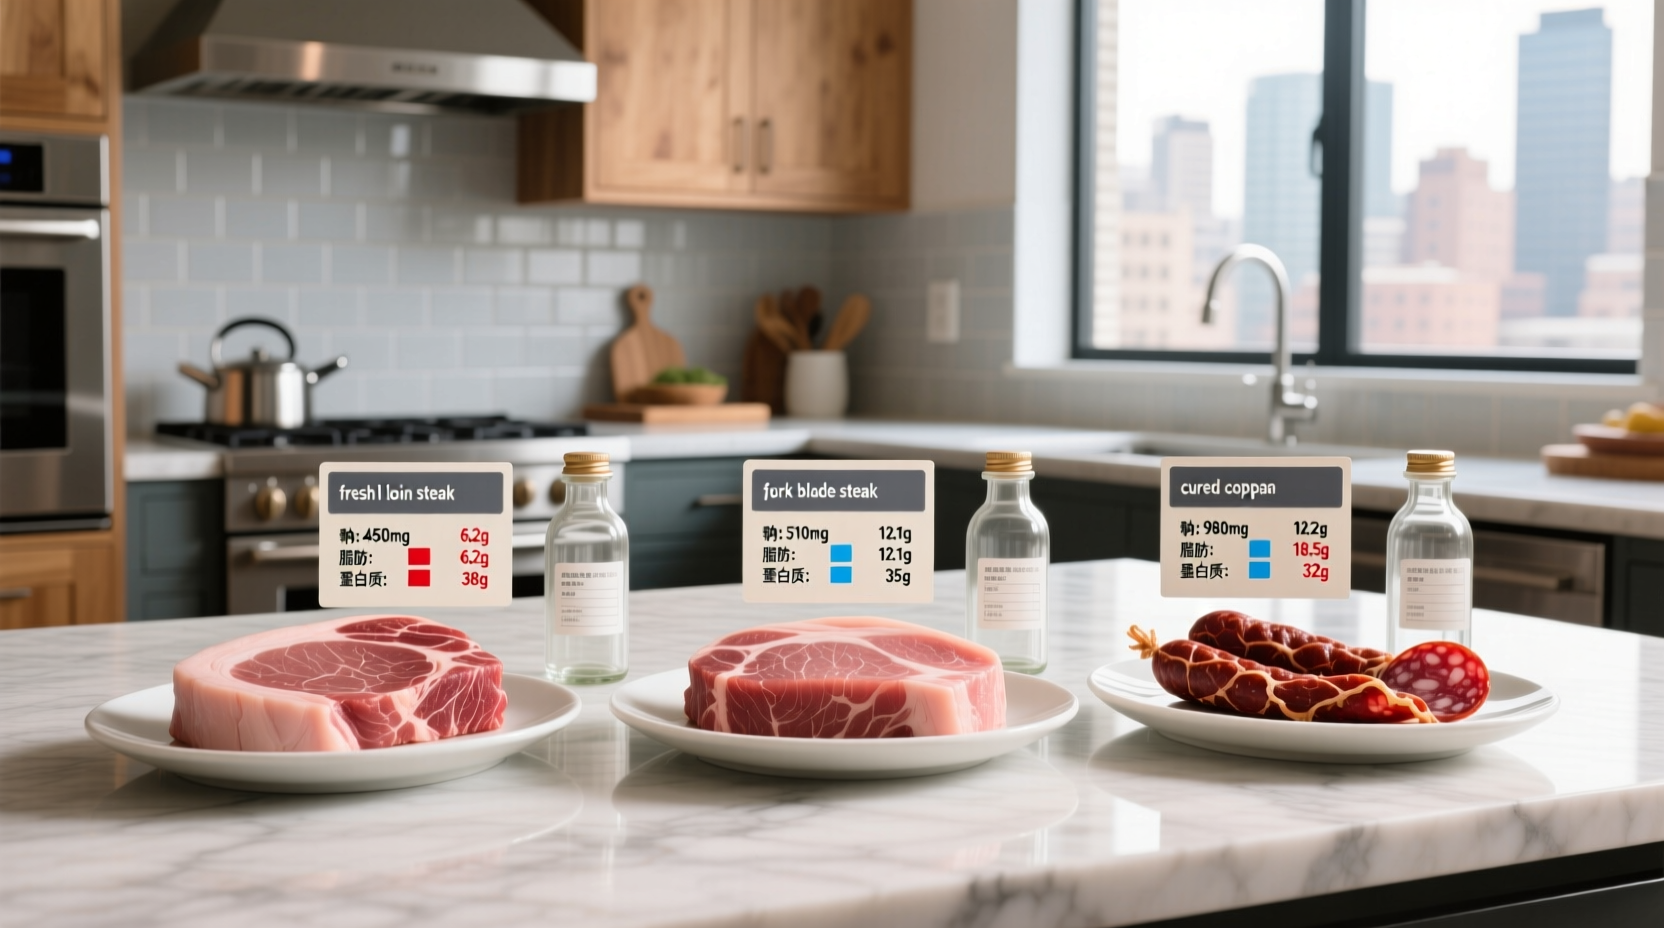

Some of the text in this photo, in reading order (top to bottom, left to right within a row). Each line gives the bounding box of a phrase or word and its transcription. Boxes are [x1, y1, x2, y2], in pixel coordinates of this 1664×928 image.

[386, 484, 412, 500] loin
[417, 484, 455, 500] steak
[797, 482, 836, 498] blade
[839, 483, 878, 498] steak
[1181, 479, 1220, 495] cured
[363, 527, 410, 546] 450mg
[460, 527, 489, 546] 6.2g
[786, 526, 829, 544] 510mg
[878, 526, 912, 543] 12.1g
[1203, 521, 1248, 539] 980mg
[1293, 521, 1328, 538] 12.2g
[460, 549, 489, 568] 6.2g
[878, 547, 912, 564] 12.1g
[1293, 542, 1329, 560] 18.5g
[461, 571, 488, 589] 38g
[885, 568, 911, 586] 35g
[1302, 563, 1329, 582] 32g
